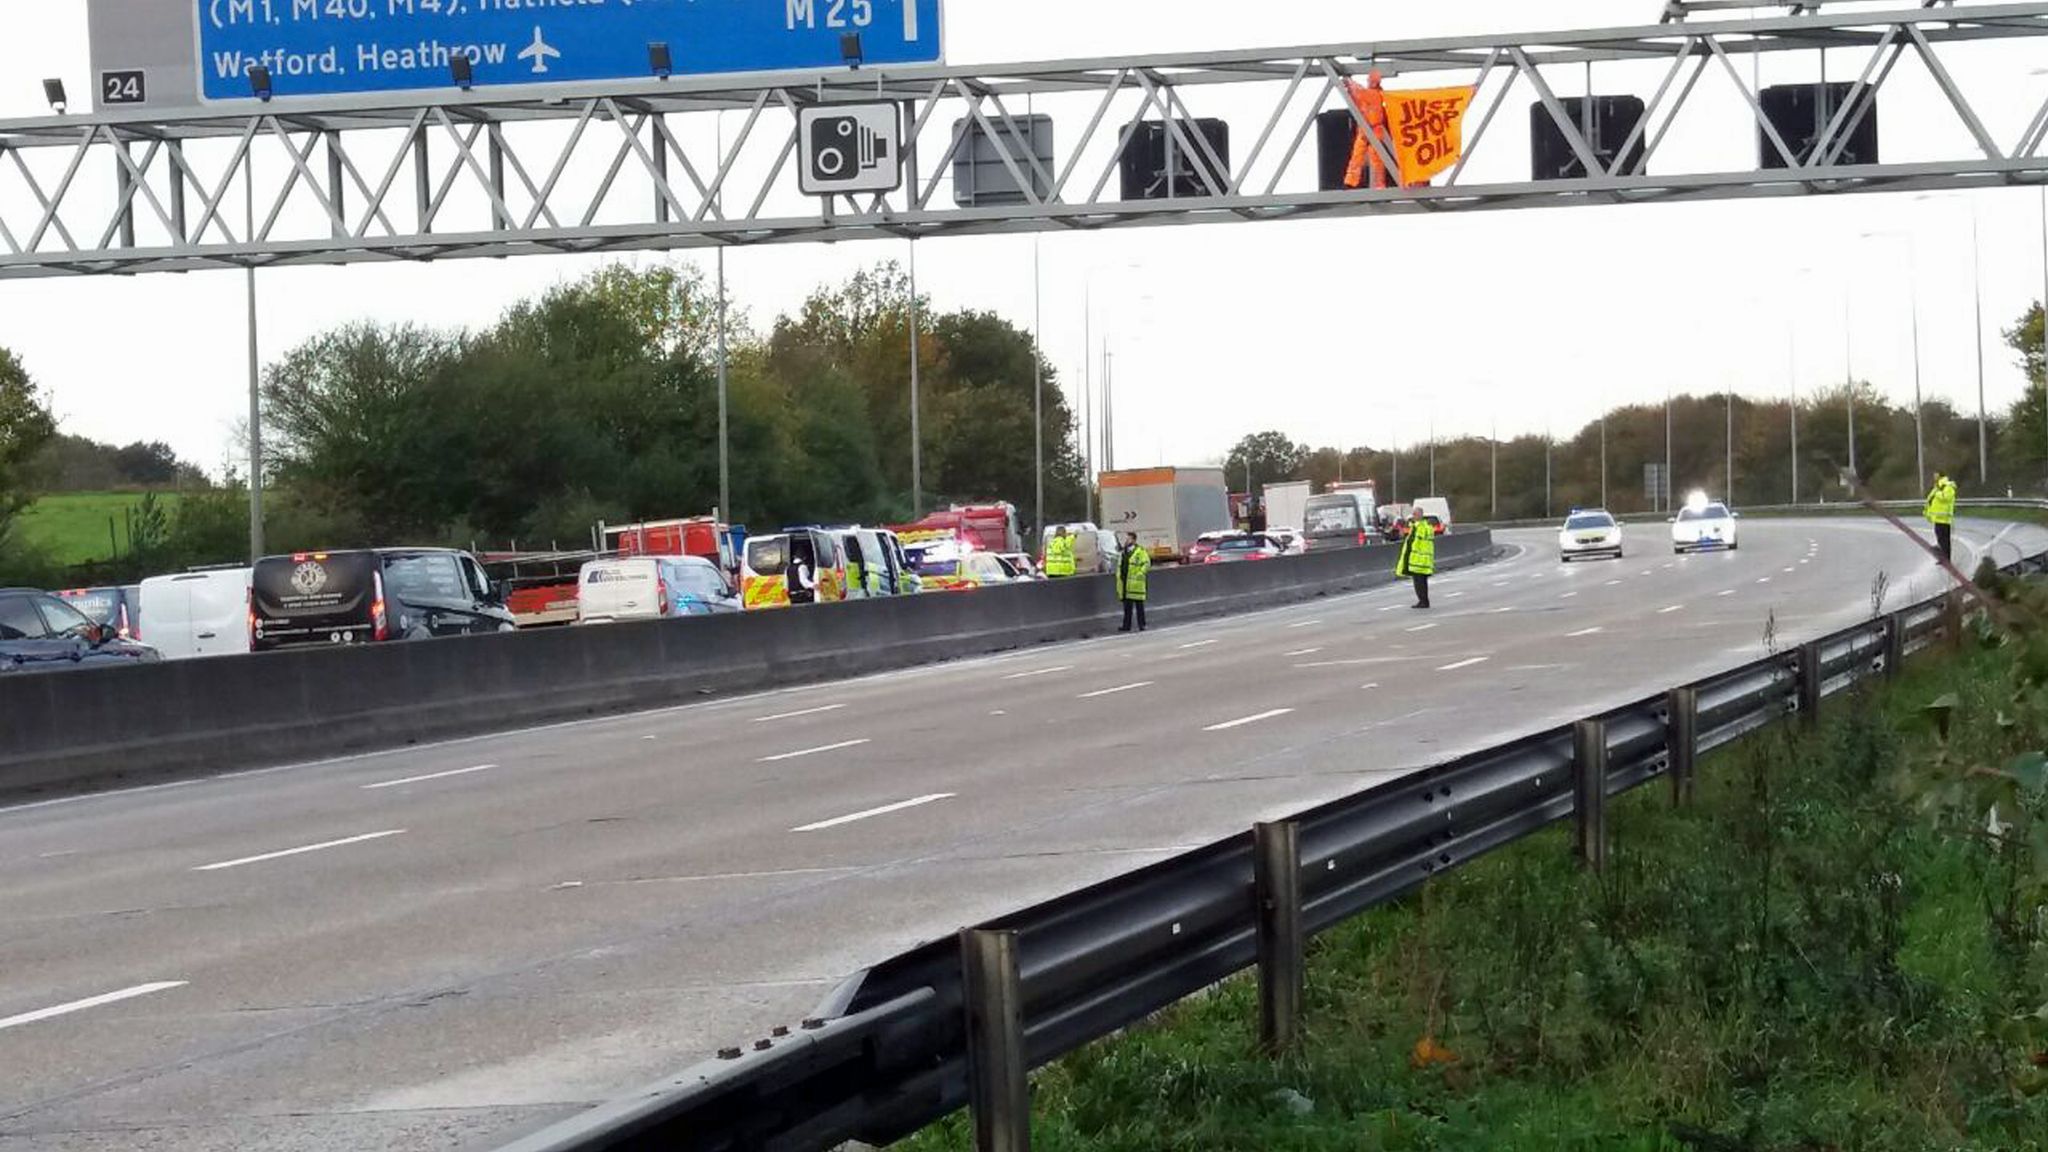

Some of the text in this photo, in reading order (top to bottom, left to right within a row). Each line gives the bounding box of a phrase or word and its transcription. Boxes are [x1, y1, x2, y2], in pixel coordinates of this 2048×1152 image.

[214, 40, 506, 78] Watford, Heathrow
[108, 76, 140, 99] 24
[1401, 97, 1463, 124] JUST
[1401, 111, 1459, 147] STOP
[1416, 136, 1453, 165] OIL
